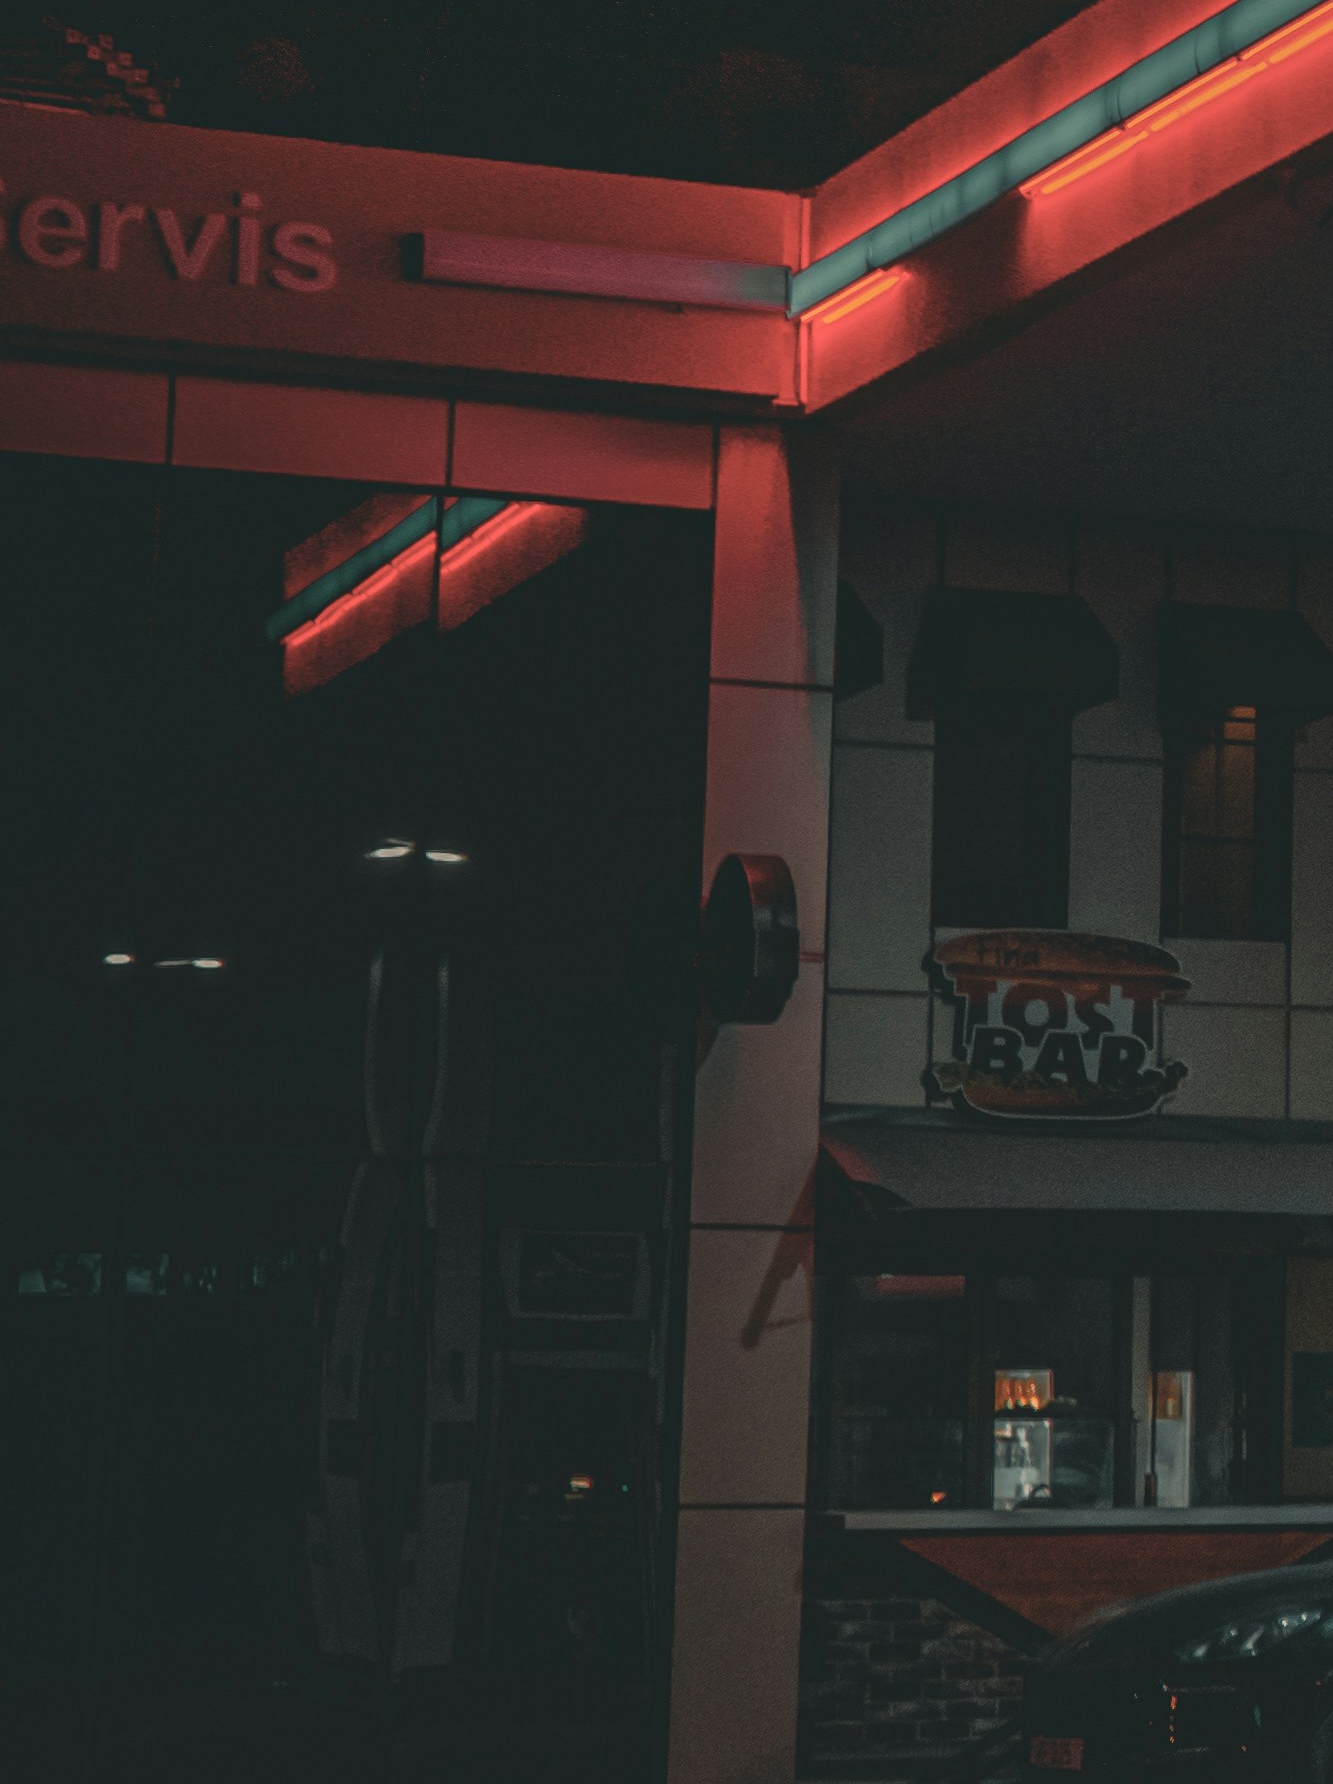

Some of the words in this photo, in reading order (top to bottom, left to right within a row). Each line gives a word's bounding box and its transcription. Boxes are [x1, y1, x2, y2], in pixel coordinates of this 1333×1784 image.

[0, 175, 339, 293] ervis
[955, 975, 1164, 1049] TOST
[969, 1028, 1166, 1089] BAR
